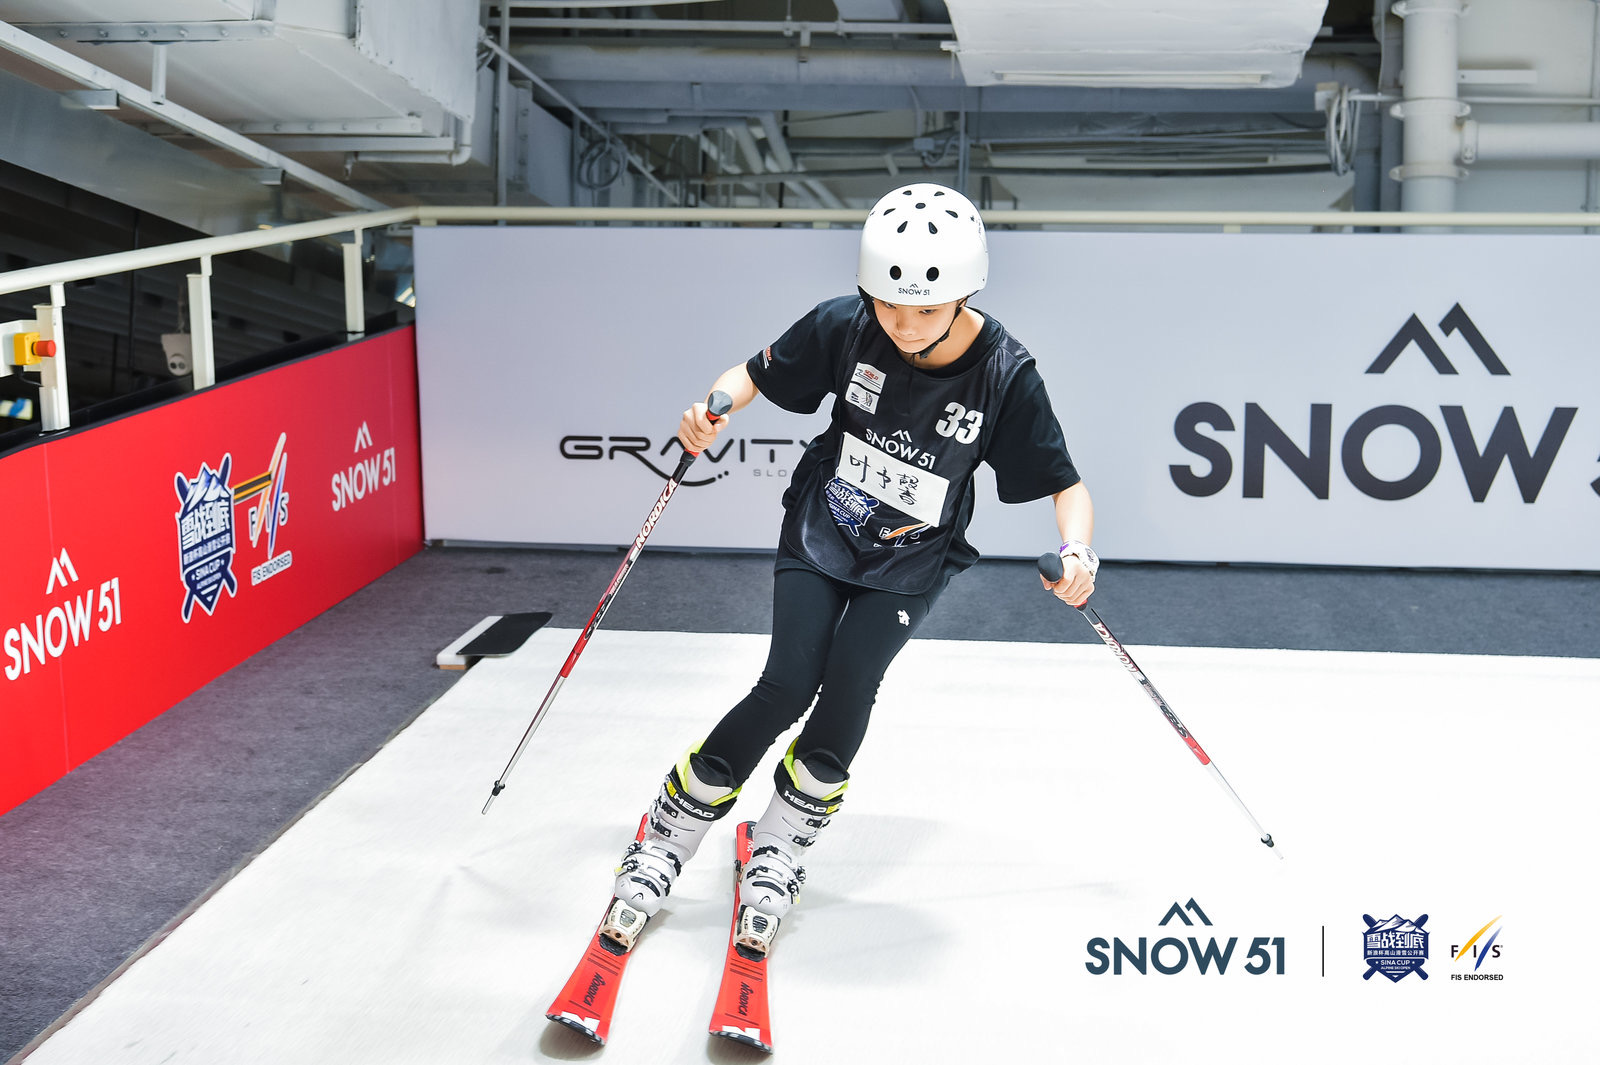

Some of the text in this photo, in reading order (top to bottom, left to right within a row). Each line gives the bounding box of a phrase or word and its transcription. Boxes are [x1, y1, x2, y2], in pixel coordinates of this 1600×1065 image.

[898, 287, 922, 296] SNOW
[935, 401, 984, 445] 33
[559, 435, 808, 476] GRAVIT
[865, 428, 937, 470] SNOW 51
[1168, 401, 1579, 504] SNOW
[331, 446, 397, 512] SNOW 51
[181, 499, 231, 551] 雪战到底
[634, 478, 678, 550] NORDICA
[4, 576, 122, 681] SNOW 51
[674, 793, 716, 819] HEAD
[783, 789, 827, 814] HEAD
[583, 972, 606, 1007] NORDICA
[738, 981, 754, 1017] NORDICA
